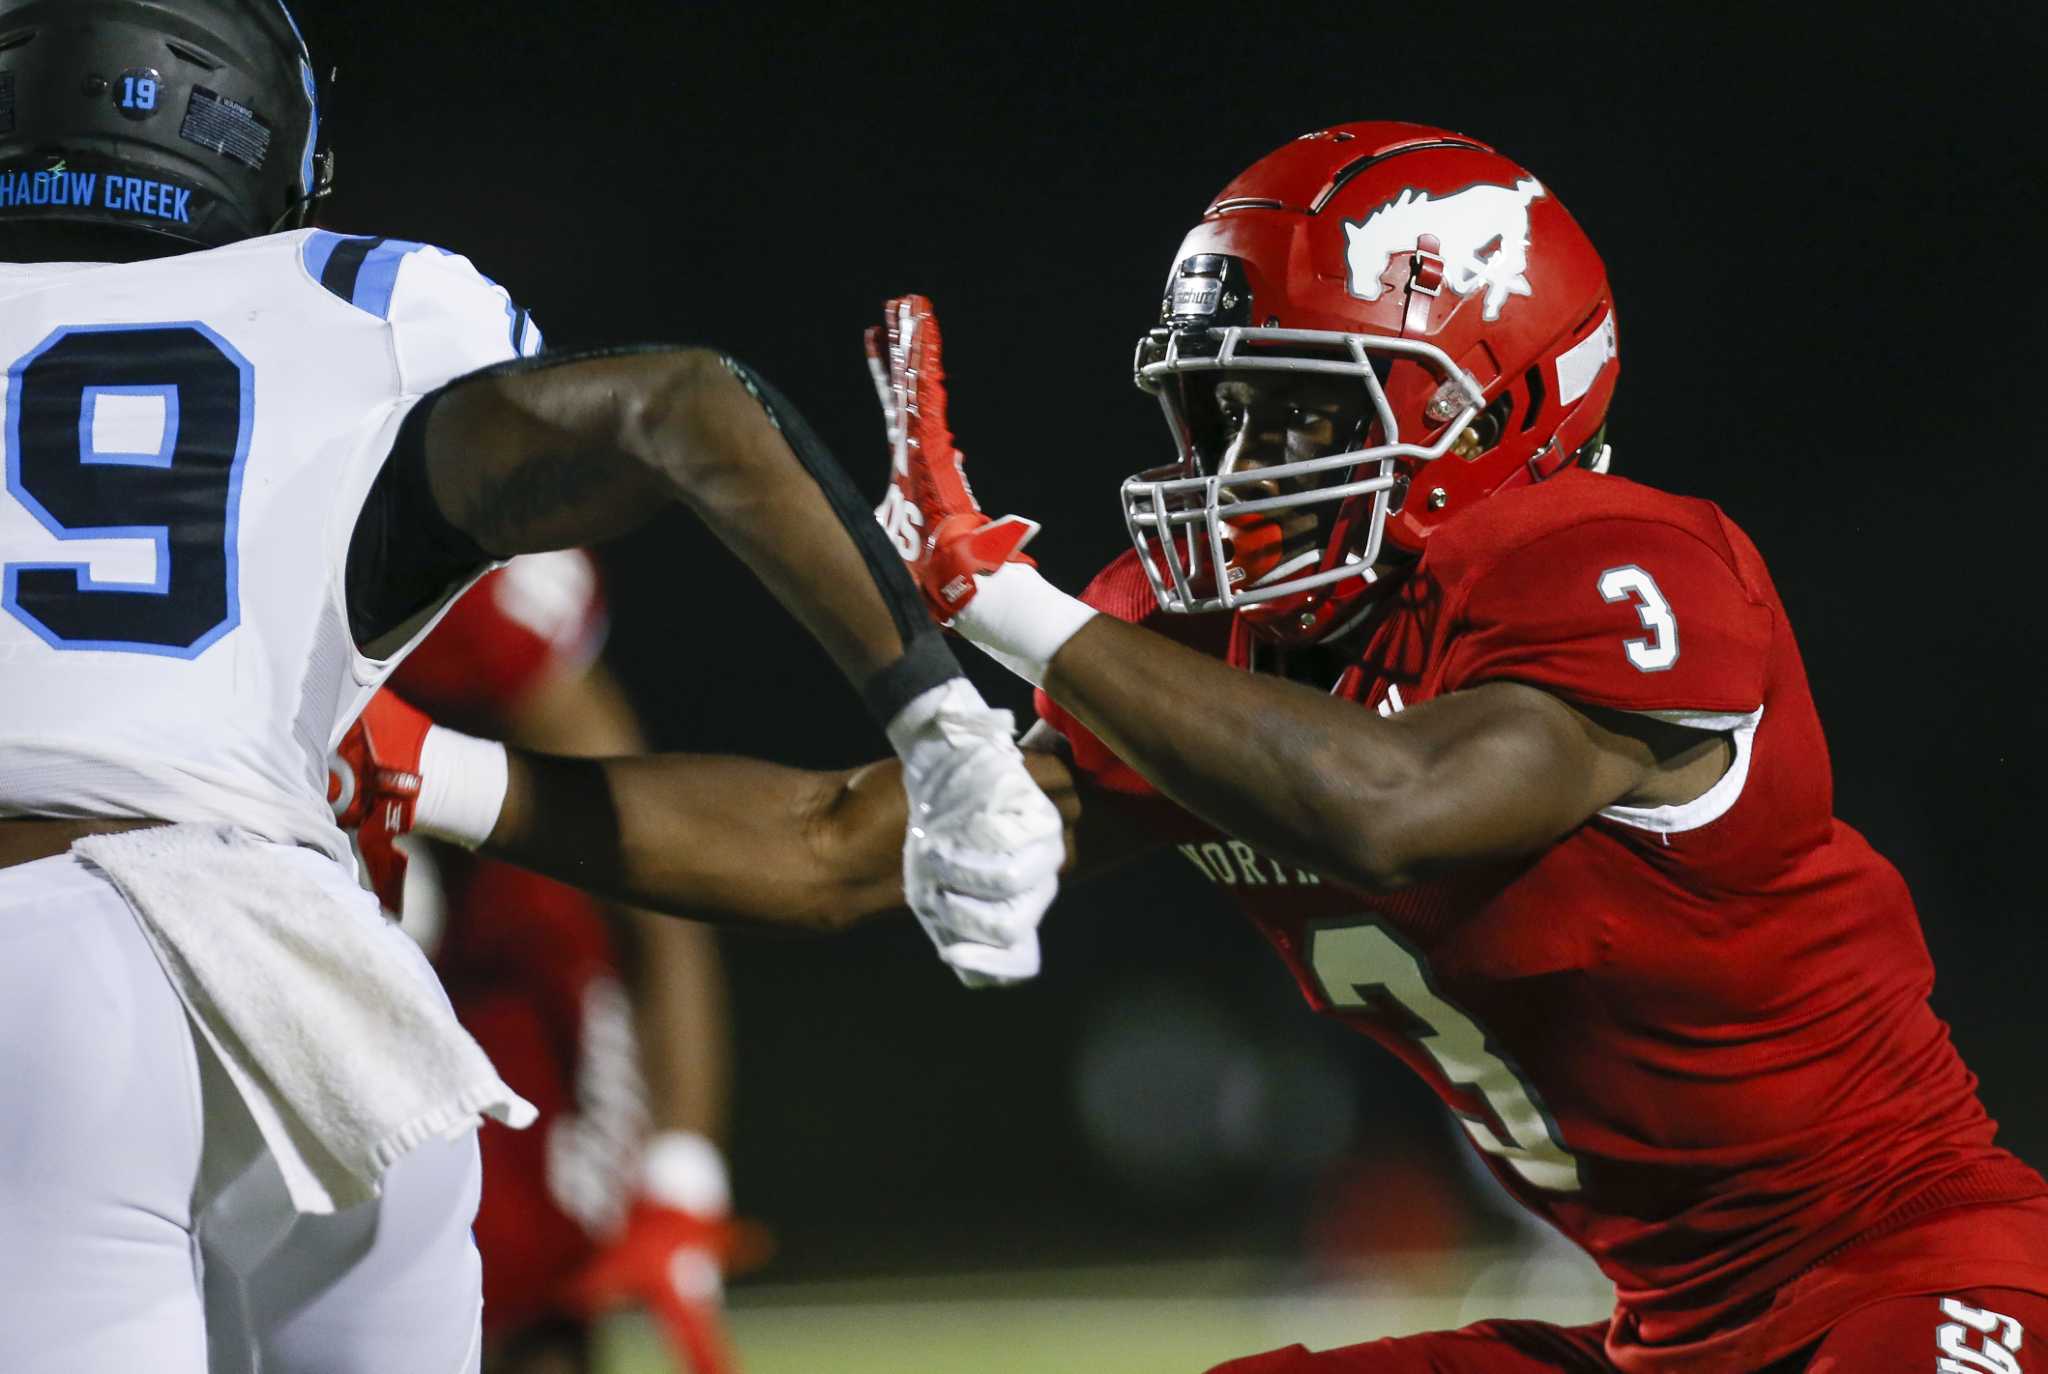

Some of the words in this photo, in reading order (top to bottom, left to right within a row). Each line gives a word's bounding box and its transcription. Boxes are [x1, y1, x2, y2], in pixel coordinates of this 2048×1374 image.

[121, 77, 157, 111] 19
[104, 173, 192, 224] CREEK
[2, 320, 255, 661] 9
[1597, 564, 1680, 672] 3
[1176, 840, 1320, 884] NOR
[1309, 922, 1584, 1192] 3
